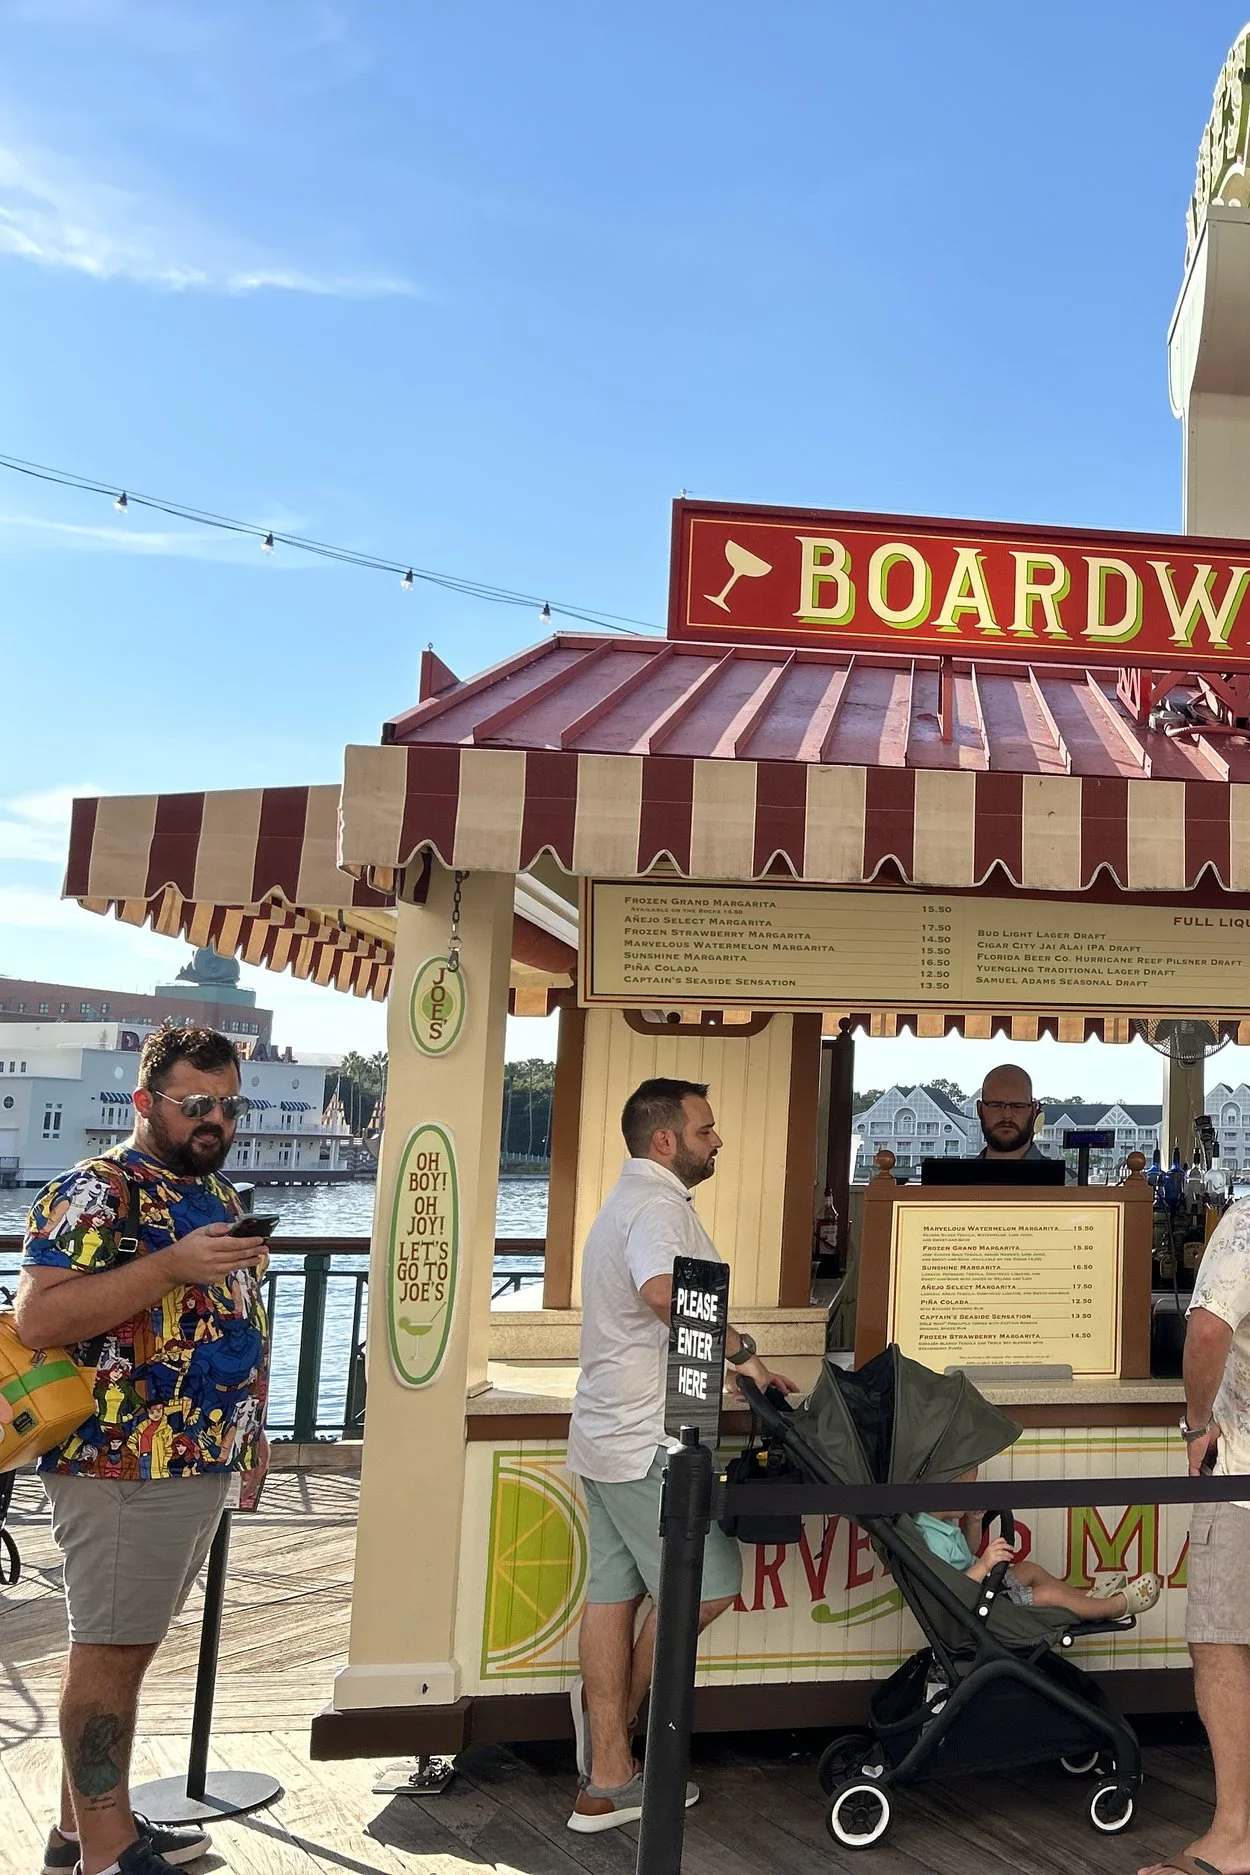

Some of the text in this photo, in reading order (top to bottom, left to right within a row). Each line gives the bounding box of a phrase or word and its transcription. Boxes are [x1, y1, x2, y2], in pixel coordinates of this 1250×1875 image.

[623, 896, 952, 913] FROZEN GRAND MARGARITA 15.50
[662, 916, 705, 925] SELECT
[708, 917, 772, 927] MARGARITA
[921, 923, 952, 932] 17.50
[1173, 916, 1214, 927] FULL
[623, 927, 951, 943] FROZEN STRAWBERRY MARGARITA 14.50
[977, 929, 999, 937] BUD
[1002, 930, 1033, 938] LIGHT
[1035, 931, 1070, 939] LAGER
[1072, 931, 1107, 940] DRAFT
[623, 939, 951, 955] MARVELOUS WATERMELON MARGARITA 15.50
[976, 941, 1009, 949] CIGAR
[1011, 941, 1036, 949] CITY
[1038, 942, 1056, 950] JAI
[1058, 943, 1083, 951] ALAI
[1086, 943, 1105, 952] IPA
[1108, 944, 1142, 952] DRAFT
[623, 951, 950, 966] SUNSHINE MARGARITA 16.50
[976, 952, 1020, 961] FLORIDA
[1023, 953, 1051, 962] BEER
[1053, 954, 1071, 962] CO.
[1074, 955, 1134, 964] HURRICANE
[1136, 956, 1163, 964] REEF
[1165, 957, 1207, 966] PILSNER
[1210, 958, 1243, 966] DRAFT
[653, 963, 699, 972] COLADA
[920, 970, 950, 978] 12.50
[975, 964, 1034, 973] YUENGLING
[1036, 965, 1104, 974] TRADITIONAL
[1106, 967, 1140, 975] LAGER
[1142, 968, 1176, 976] DRAFT
[623, 975, 950, 990] CAPTAIN'S SEASIDE SENSATION 13.50
[975, 975, 1018, 984] SAMUEL
[1020, 977, 1056, 985] ADAMS
[1058, 977, 1112, 986] SEASONAL
[1115, 979, 1148, 987] DRAFT
[429, 968, 448, 1040] JOE'S
[416, 1152, 440, 1171] OH
[408, 1172, 448, 1192] BOY!
[414, 1196, 438, 1215] OH
[407, 1216, 445, 1236] JOY!
[399, 1241, 449, 1262] LET'S
[397, 1261, 448, 1282] GO TO
[399, 1282, 445, 1304] JOE'S
[676, 1287, 719, 1322] PLEASE
[677, 1327, 713, 1361] ENTER
[678, 1366, 708, 1400] HERE
